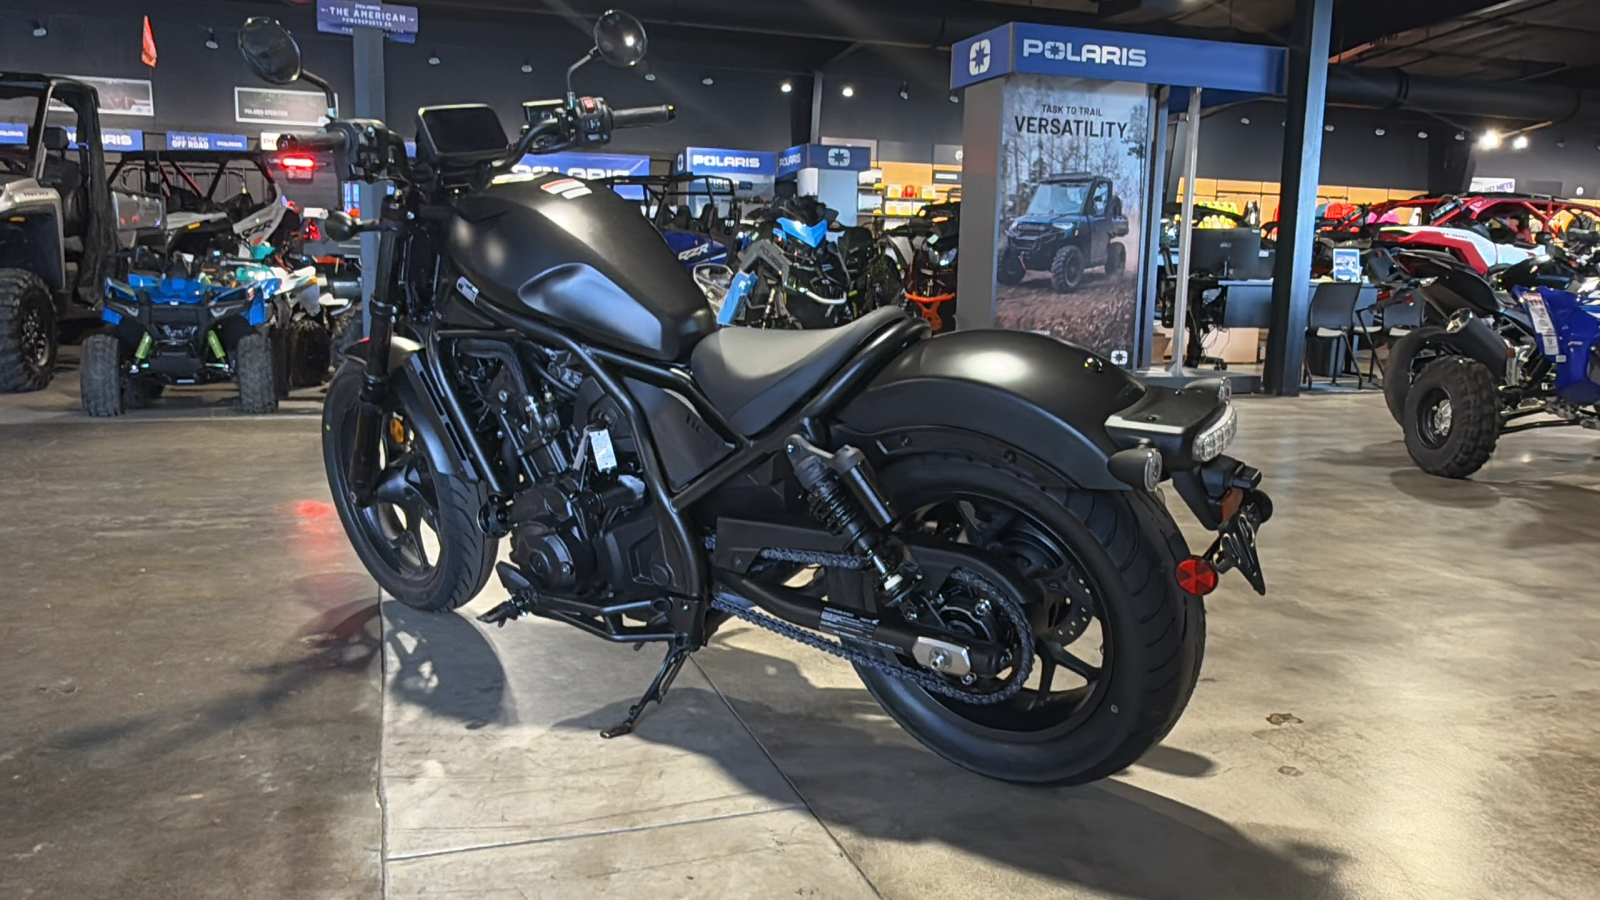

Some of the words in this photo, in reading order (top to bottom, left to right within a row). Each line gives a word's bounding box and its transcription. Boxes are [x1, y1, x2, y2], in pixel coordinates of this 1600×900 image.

[329, 6, 349, 17] THE
[353, 9, 406, 23] AMERICAN
[1022, 38, 1147, 68] POLARIS
[1041, 103, 1063, 115] TASK
[1066, 105, 1077, 115] TO
[1079, 106, 1103, 117] TRAIL
[1014, 115, 1128, 139] VERSATILITY
[172, 140, 187, 149] OFF
[188, 141, 209, 150] ROAD
[692, 154, 760, 168] POLARIS
[779, 153, 801, 167] POLARIS
[677, 243, 709, 261] RZR
